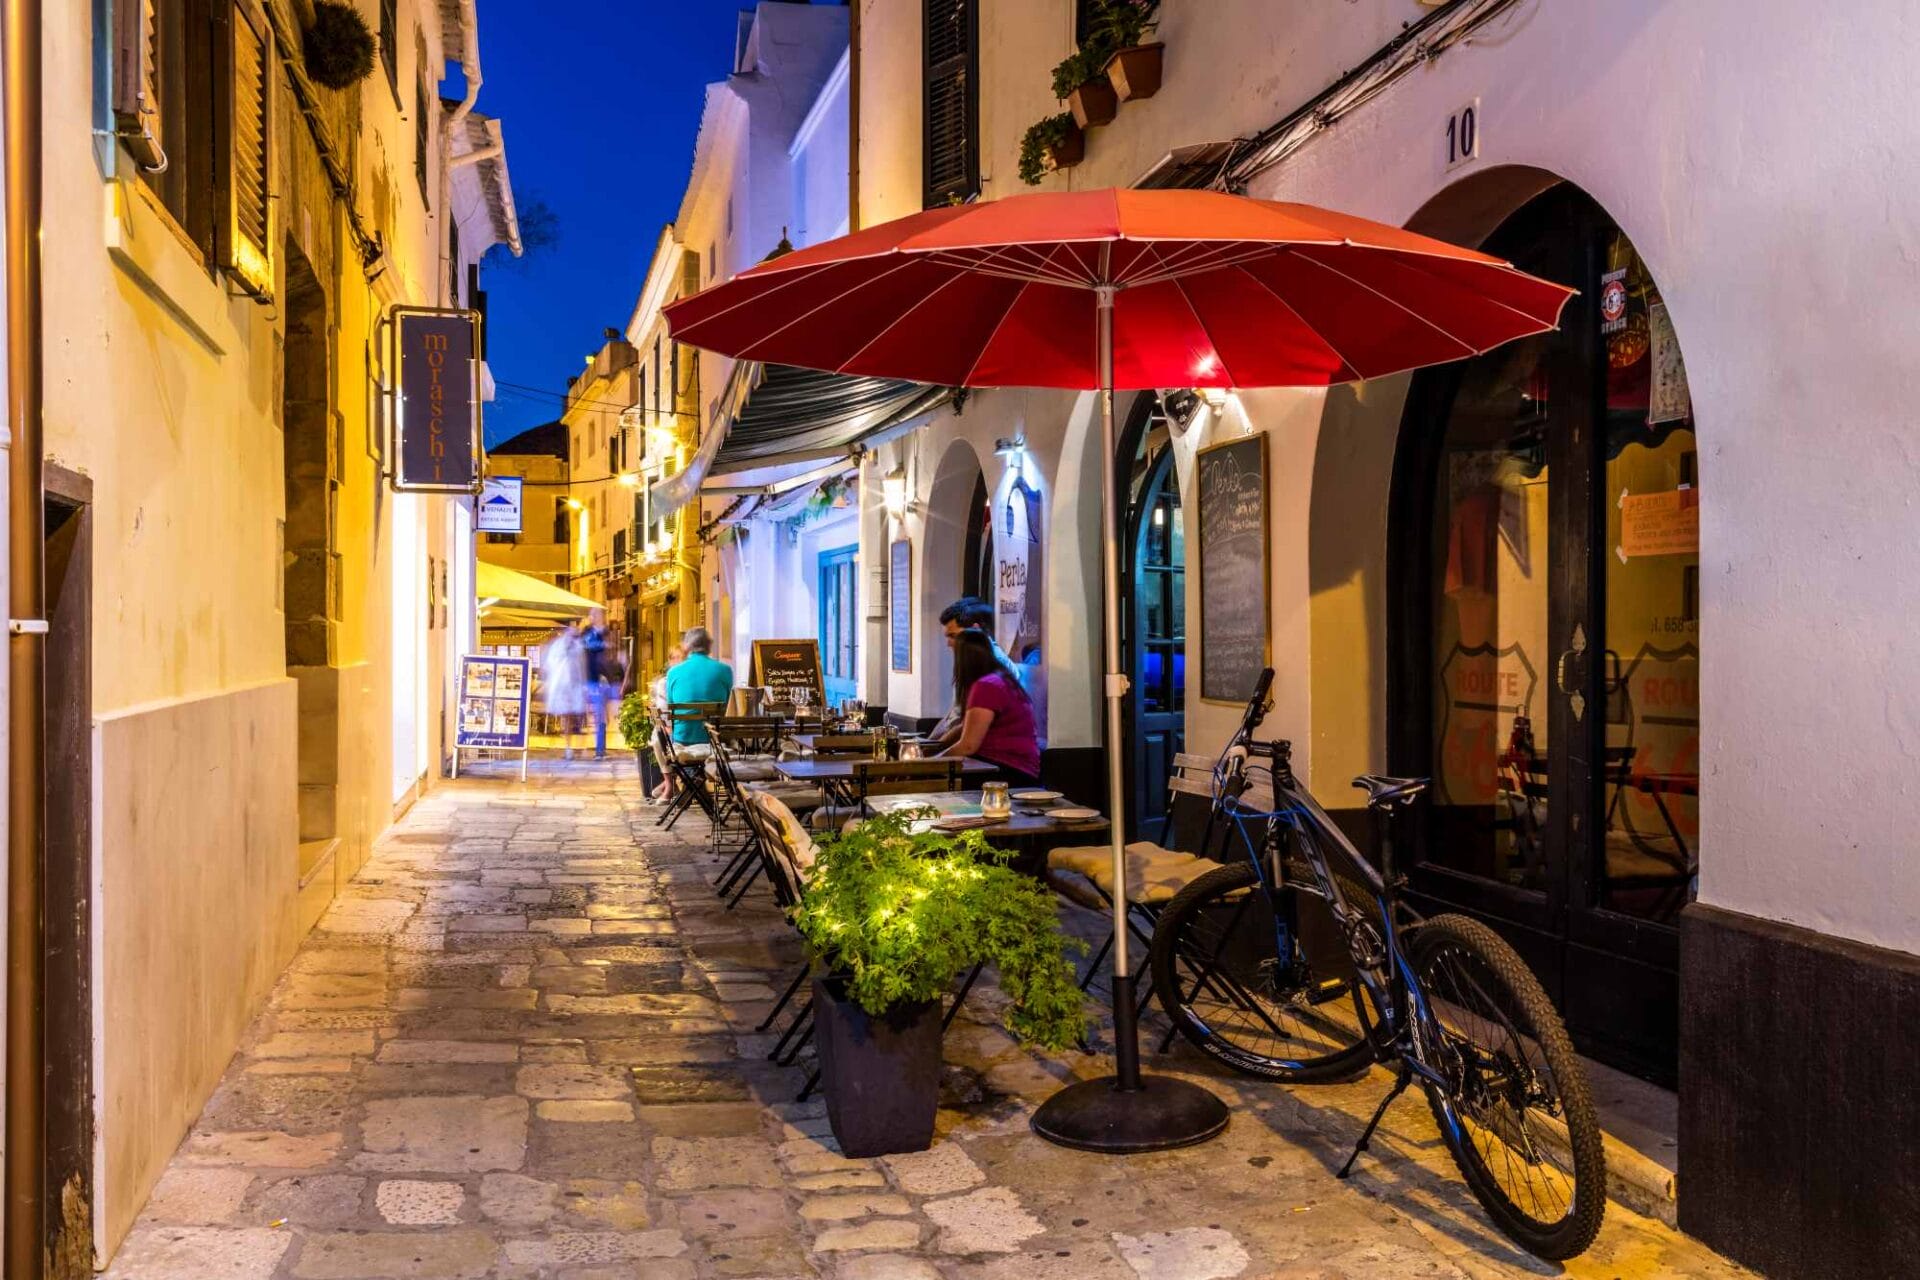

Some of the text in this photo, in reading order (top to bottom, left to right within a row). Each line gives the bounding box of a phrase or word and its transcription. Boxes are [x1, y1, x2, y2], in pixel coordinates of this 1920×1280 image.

[1446, 107, 1475, 164] 10
[423, 333, 448, 481] moraschi
[1000, 557, 1027, 589] Perla
[1455, 669, 1519, 697] ROUTE
